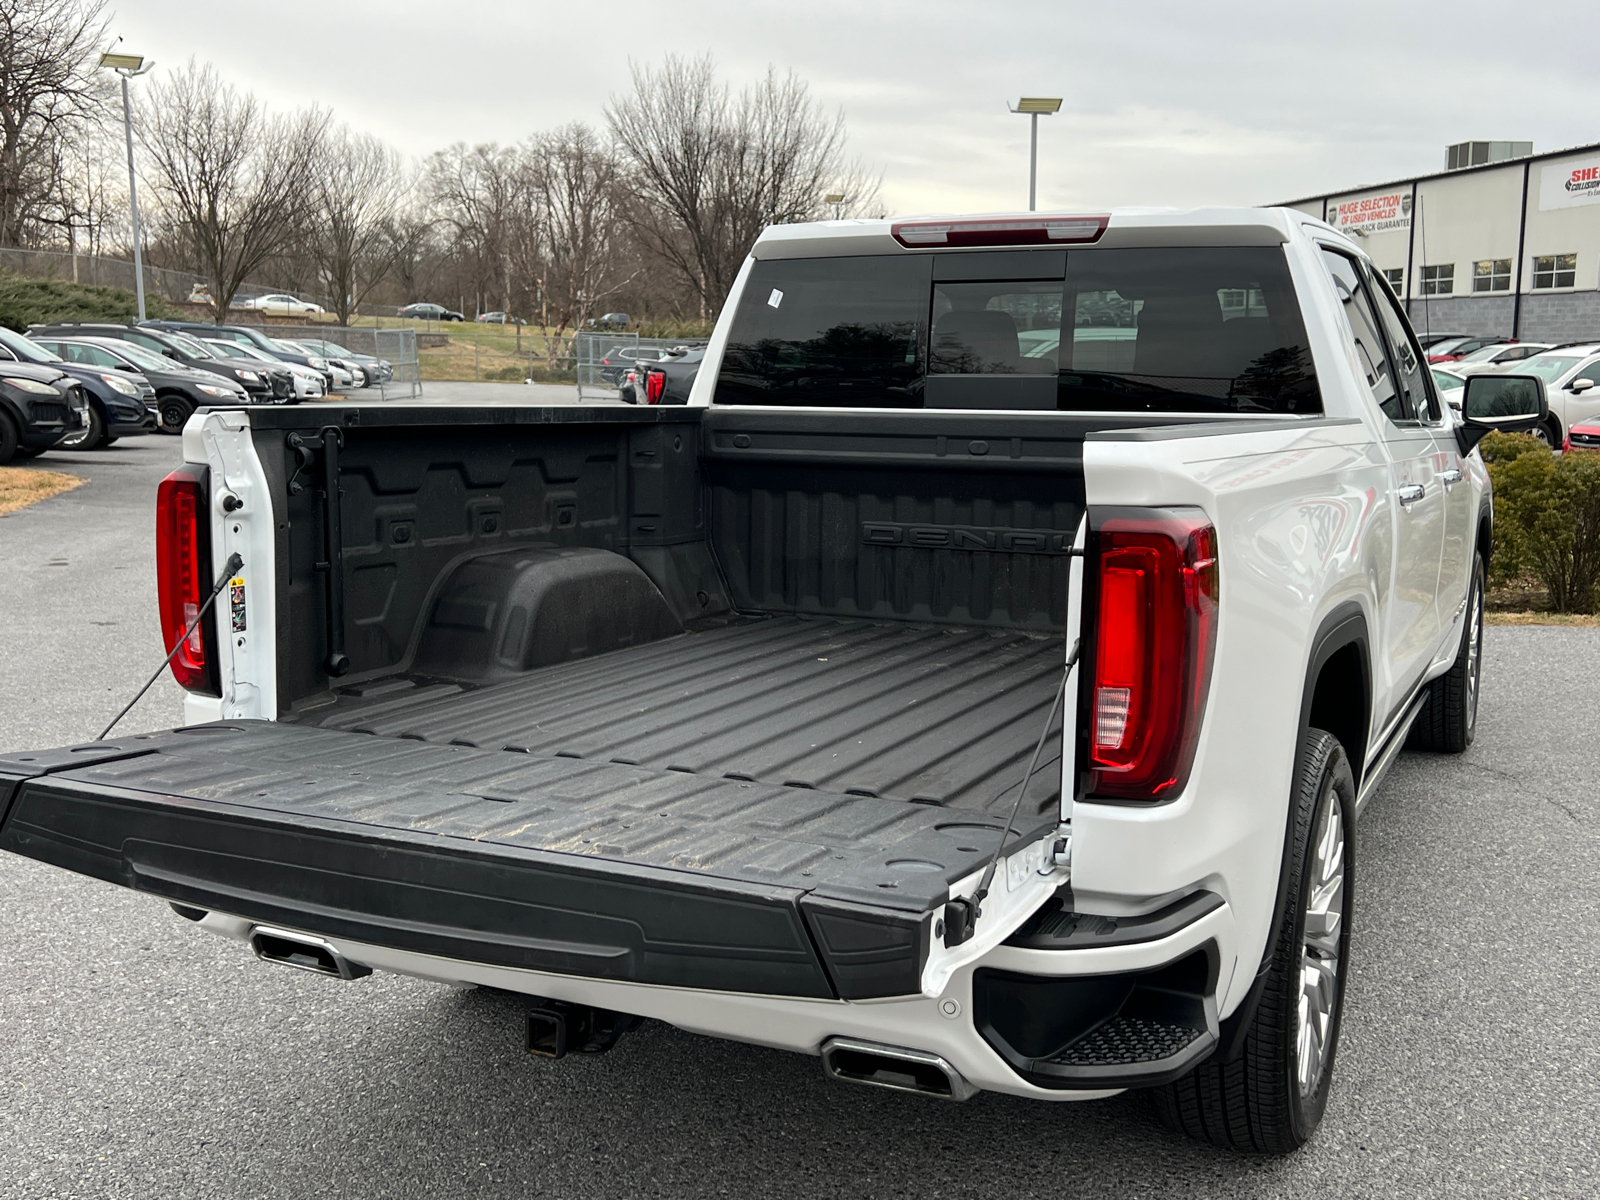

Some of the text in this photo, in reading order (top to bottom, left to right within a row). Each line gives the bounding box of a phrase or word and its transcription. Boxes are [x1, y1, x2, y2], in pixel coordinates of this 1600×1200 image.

[1572, 167, 1600, 182] SHE
[1339, 195, 1401, 215] HUGE SELECTION
[1341, 208, 1396, 225] OF USED VEHICLES
[1377, 219, 1410, 230] GUARANTEE
[863, 525, 1073, 551] DENAL
